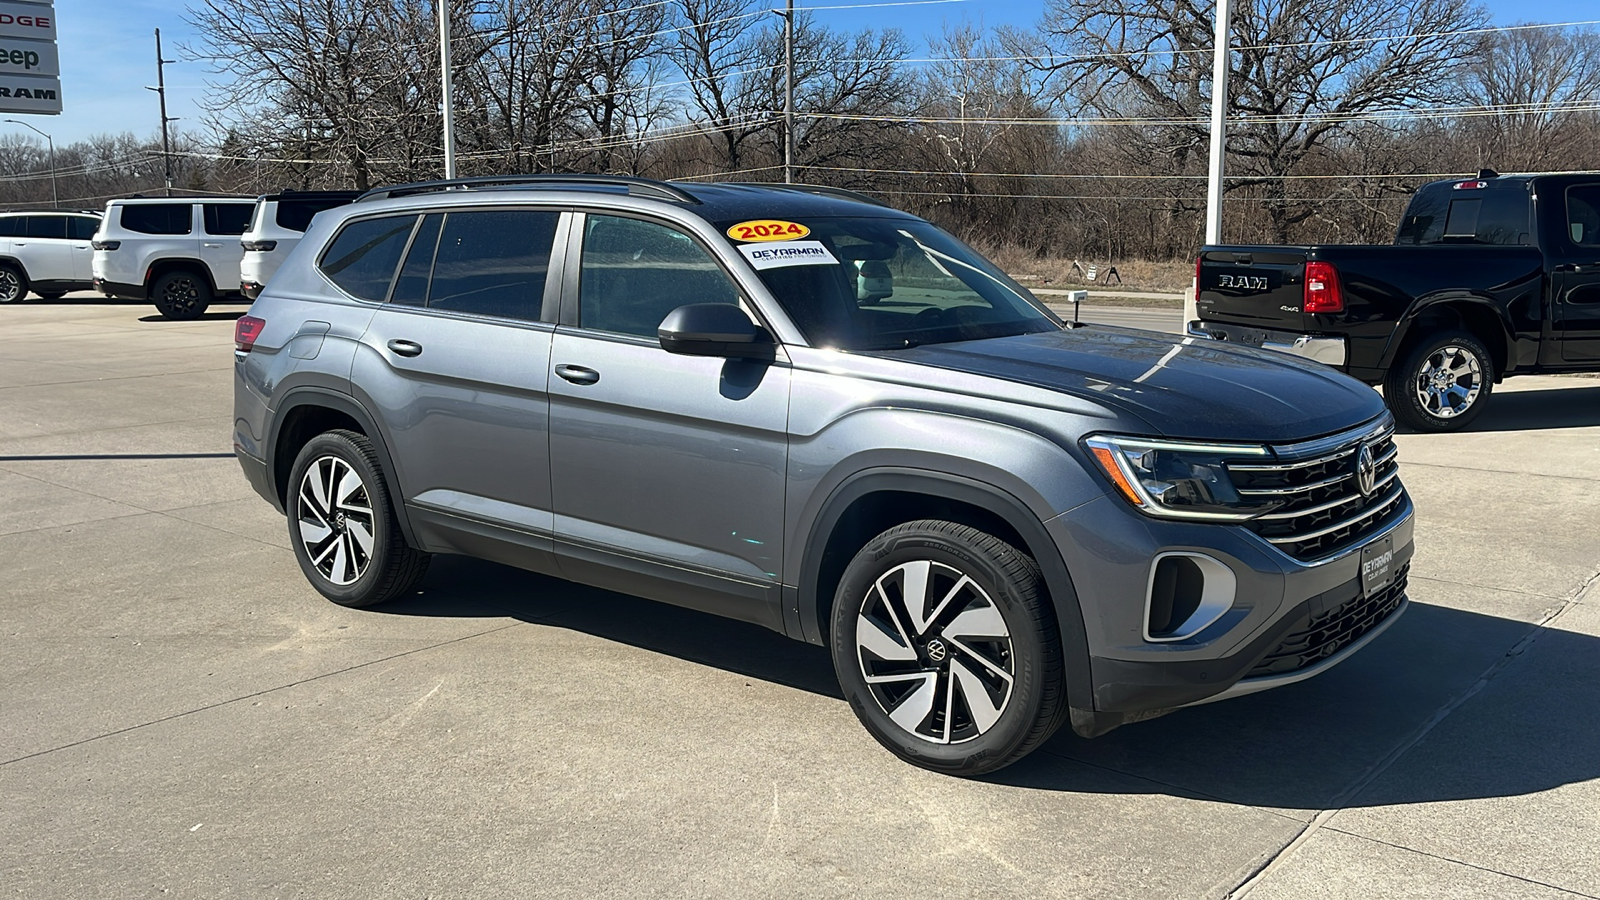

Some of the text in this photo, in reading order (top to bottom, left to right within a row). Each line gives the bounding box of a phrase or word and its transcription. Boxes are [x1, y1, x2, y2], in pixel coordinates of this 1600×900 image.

[0, 87, 56, 100] RAM
[737, 223, 803, 239] 2024
[752, 247, 825, 259] DEYARMAN
[1218, 274, 1268, 290] RAM
